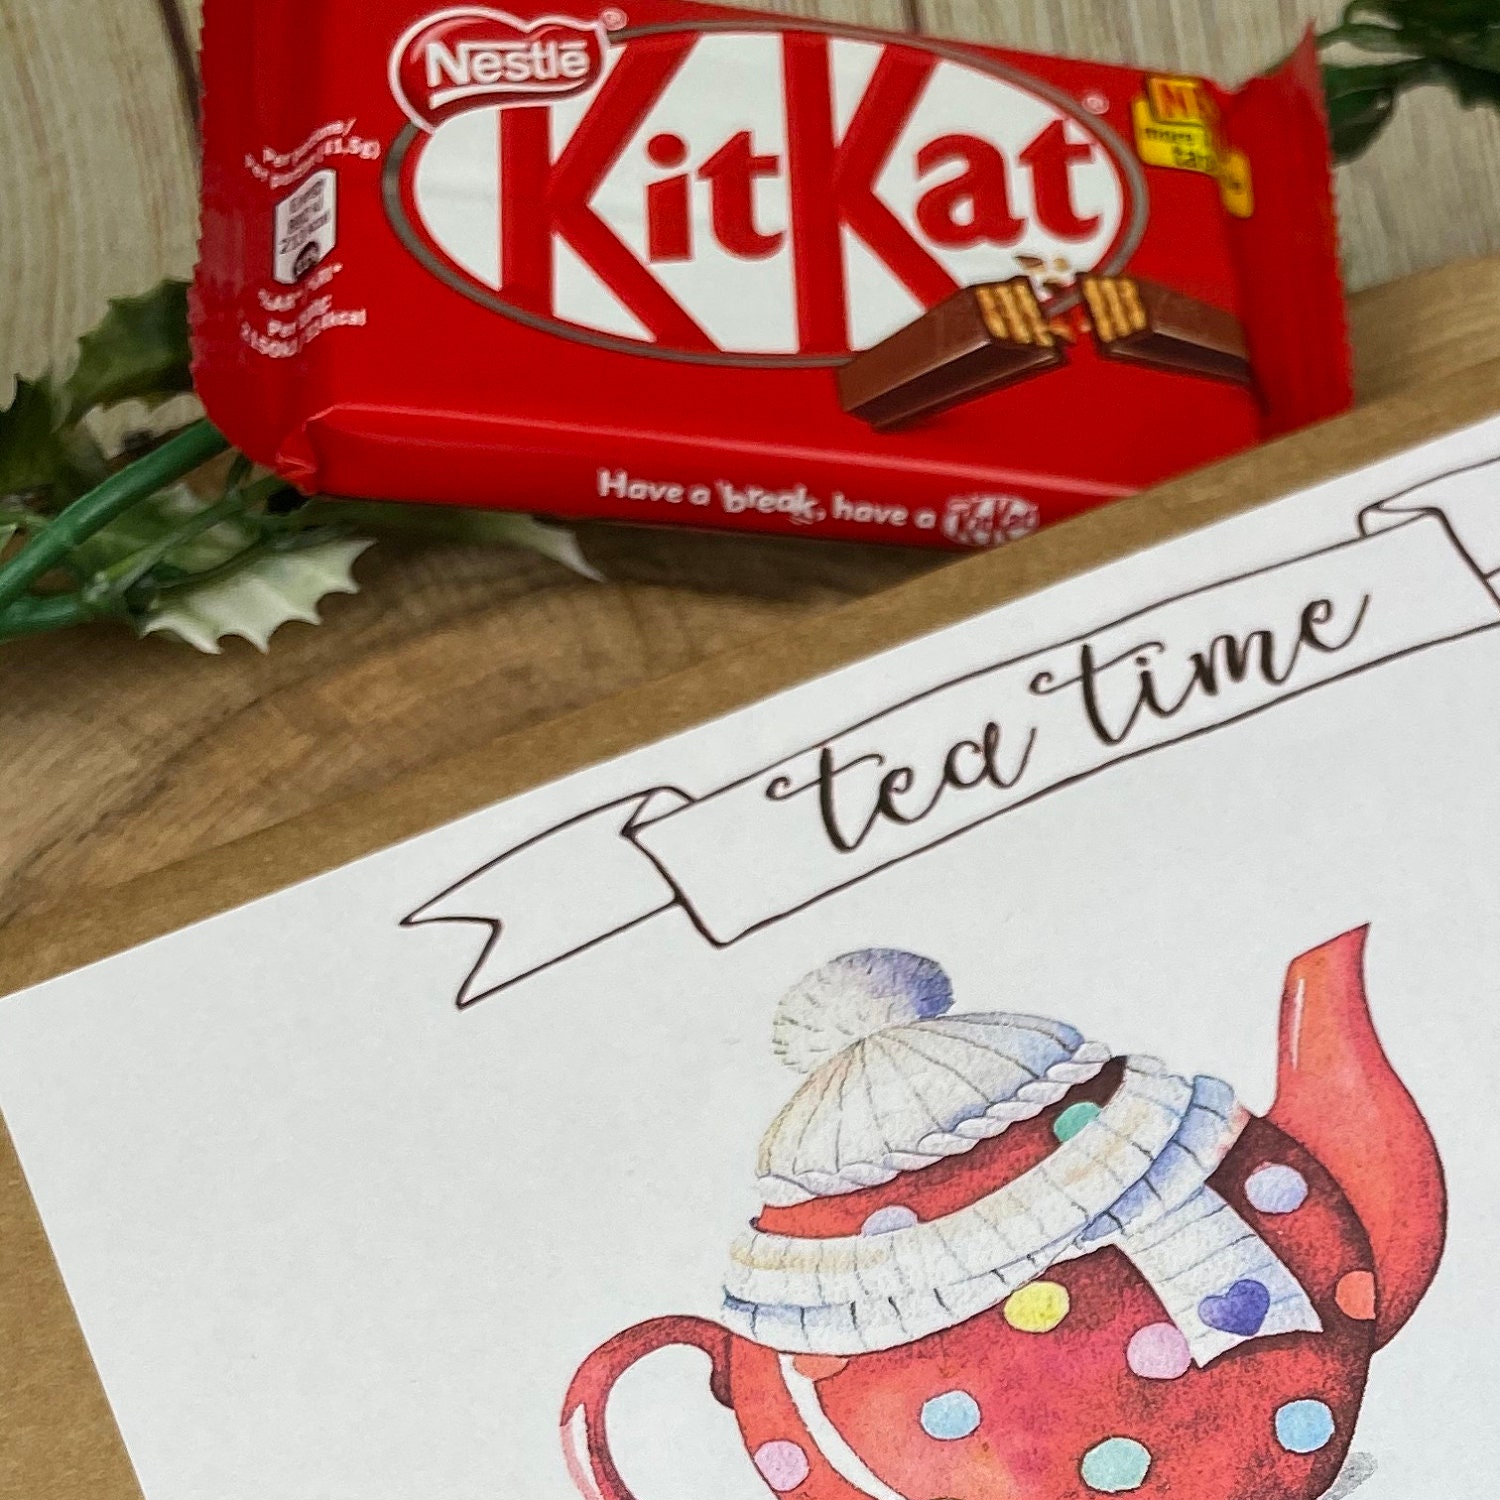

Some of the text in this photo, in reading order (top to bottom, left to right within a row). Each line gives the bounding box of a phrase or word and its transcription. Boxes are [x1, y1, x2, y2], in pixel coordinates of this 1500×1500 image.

[497, 30, 1103, 354] KitKat
[597, 467, 684, 503] Have
[688, 484, 711, 506] a
[832, 491, 908, 526] have
[914, 510, 937, 529] a
[767, 593, 1371, 852] tea time
